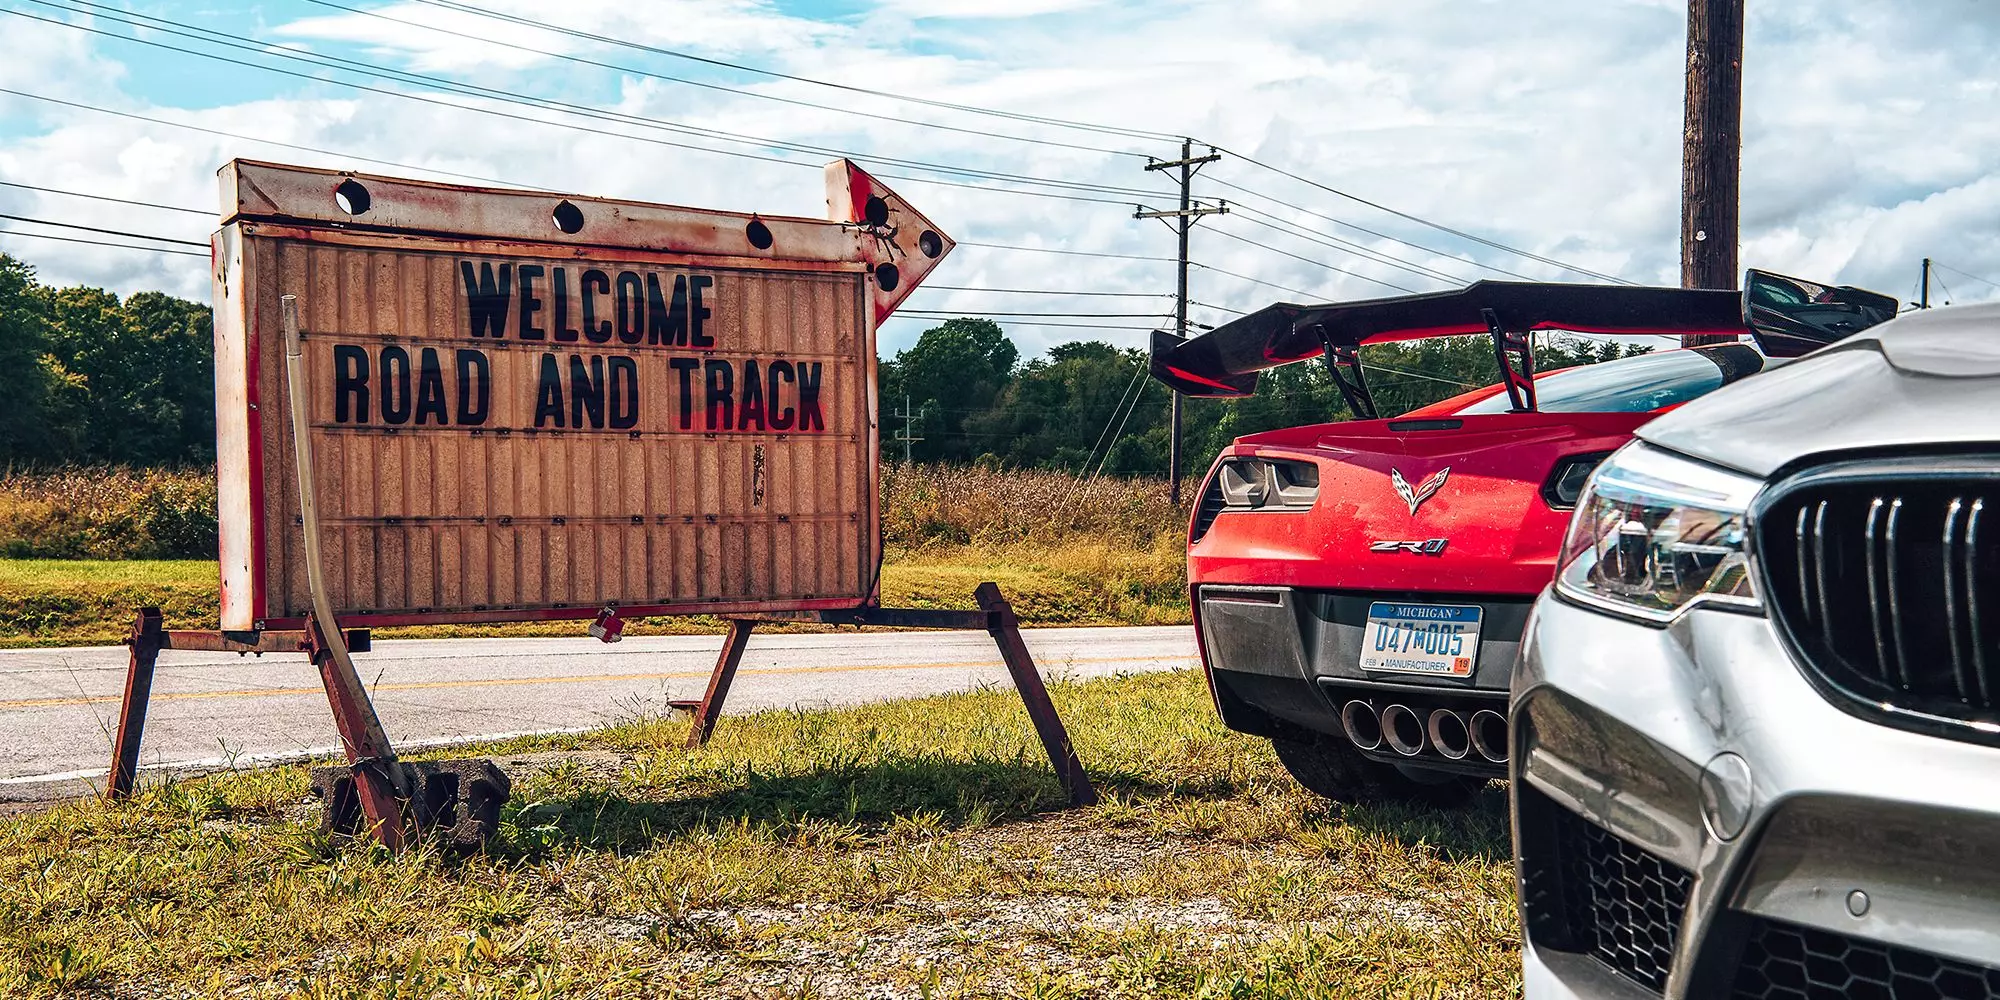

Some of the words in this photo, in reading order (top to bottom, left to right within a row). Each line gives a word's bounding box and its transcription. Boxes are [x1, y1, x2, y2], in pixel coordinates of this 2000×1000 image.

[460, 260, 716, 349] WELCOME
[333, 344, 491, 427] ROAD
[533, 352, 640, 430] AND
[669, 357, 825, 432] TRACK
[1369, 538, 1449, 554] ZR1
[1396, 607, 1453, 619] MICHIGAN
[1375, 621, 1465, 656] 047M005
[1365, 658, 1377, 667] FEB
[1385, 659, 1447, 672] MANUFACTURER
[1459, 659, 1469, 668] 19
